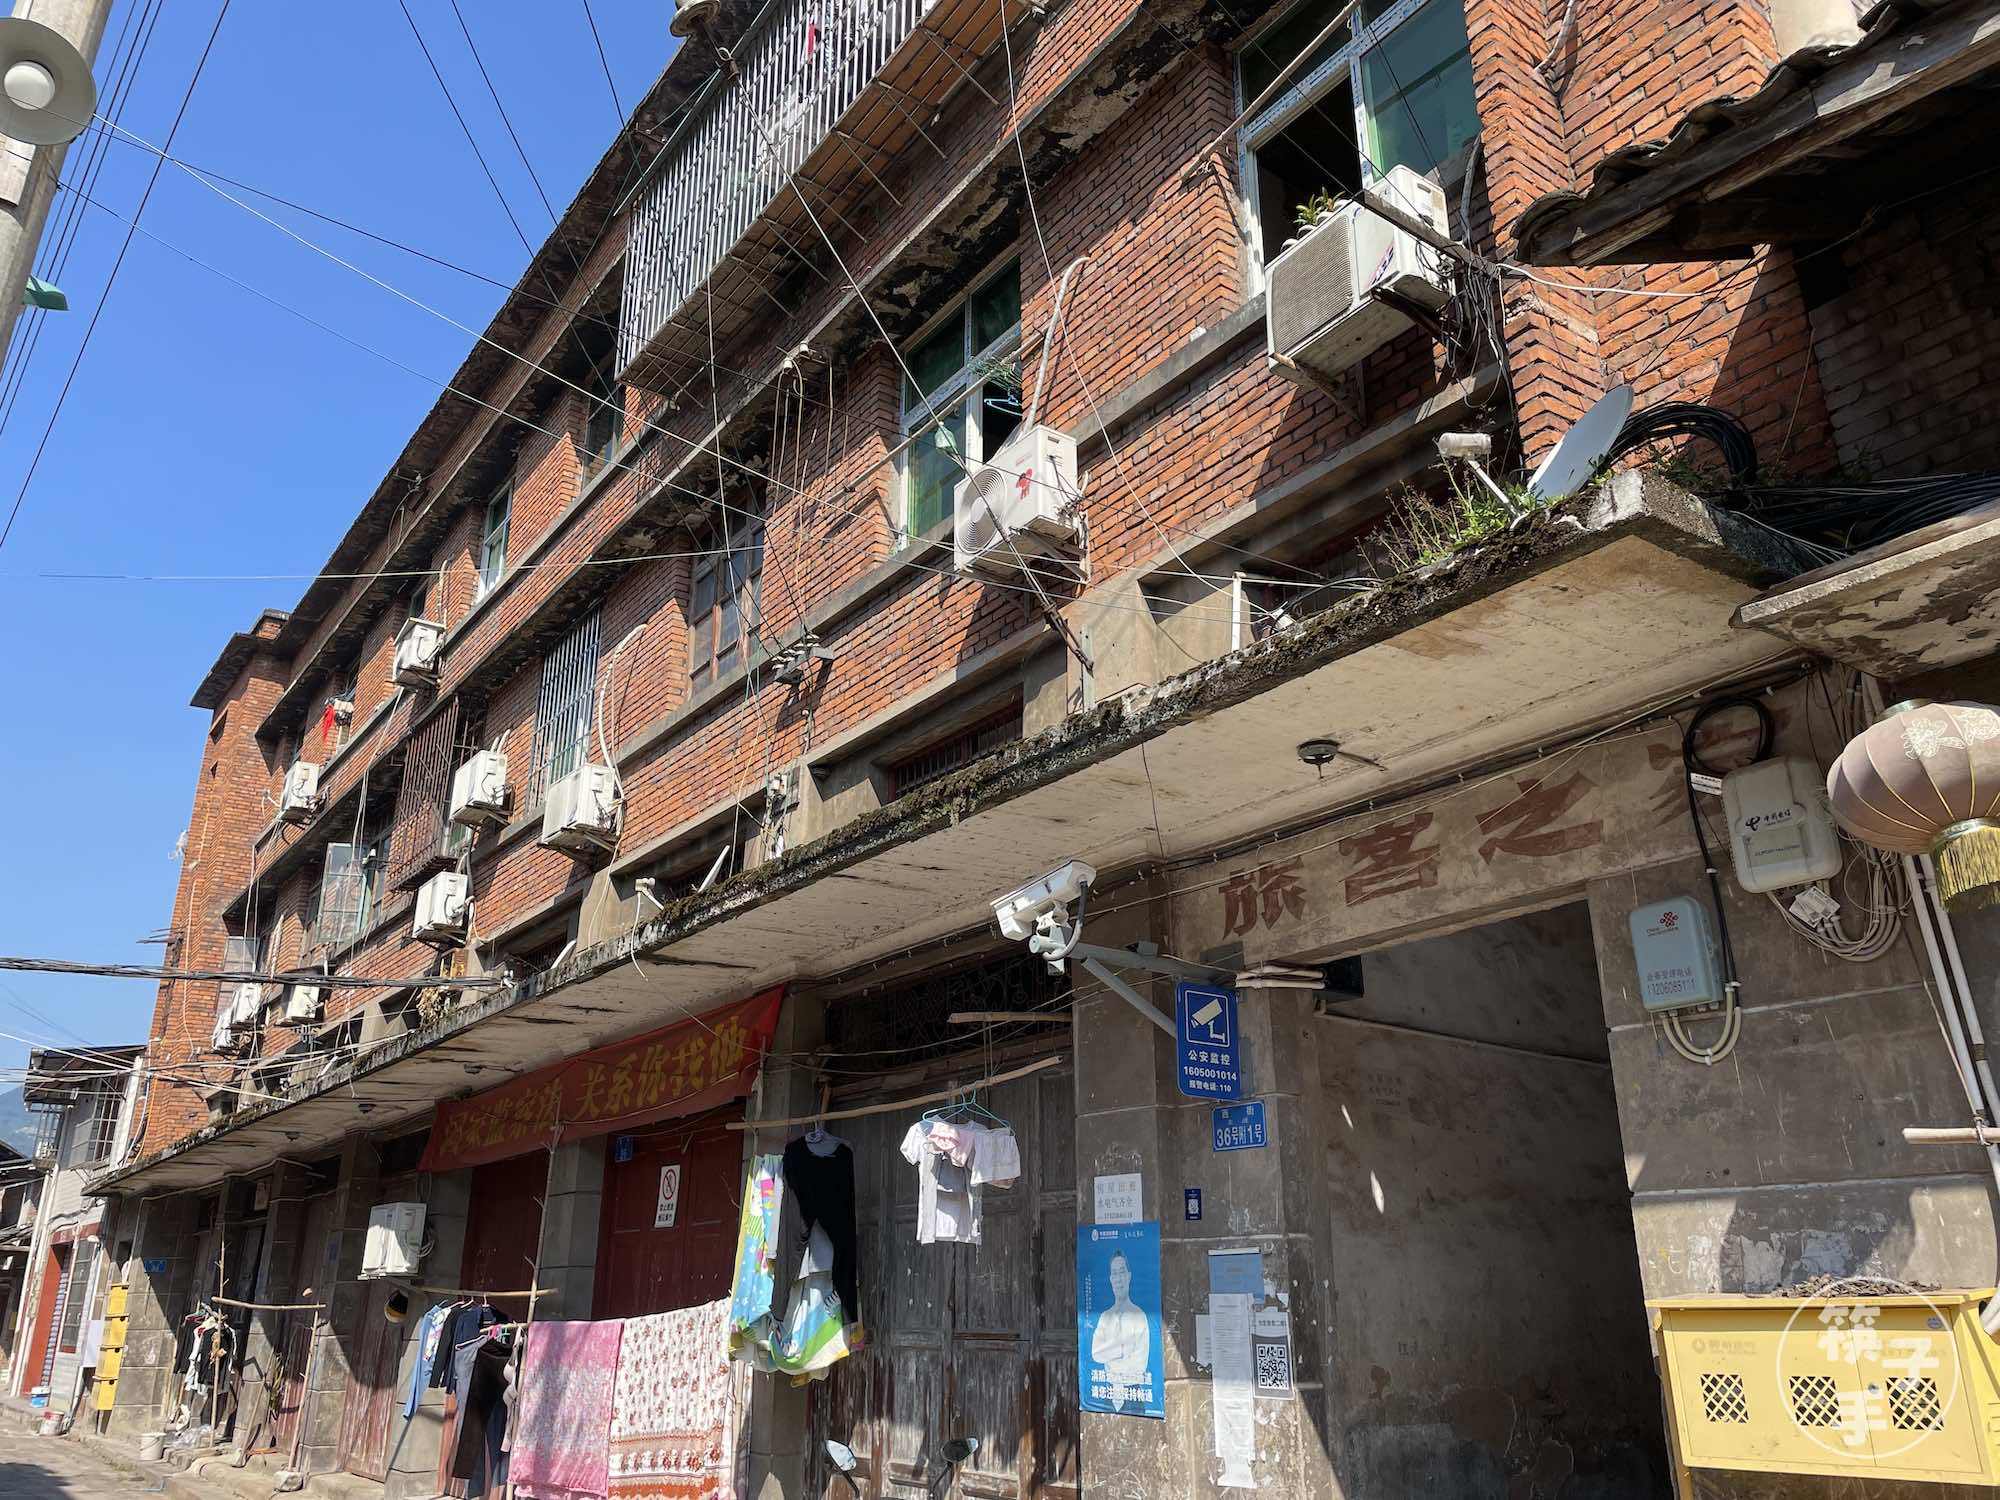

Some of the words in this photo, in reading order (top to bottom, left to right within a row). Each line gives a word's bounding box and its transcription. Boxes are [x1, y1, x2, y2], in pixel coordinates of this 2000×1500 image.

[1764, 809, 1791, 822] 中国电信
[1188, 1050, 1231, 1066] 公安监控
[574, 1015, 748, 1120] 关系你我他
[1183, 1066, 1237, 1081] 1605001014
[1216, 1123, 1262, 1148] 36号附1号
